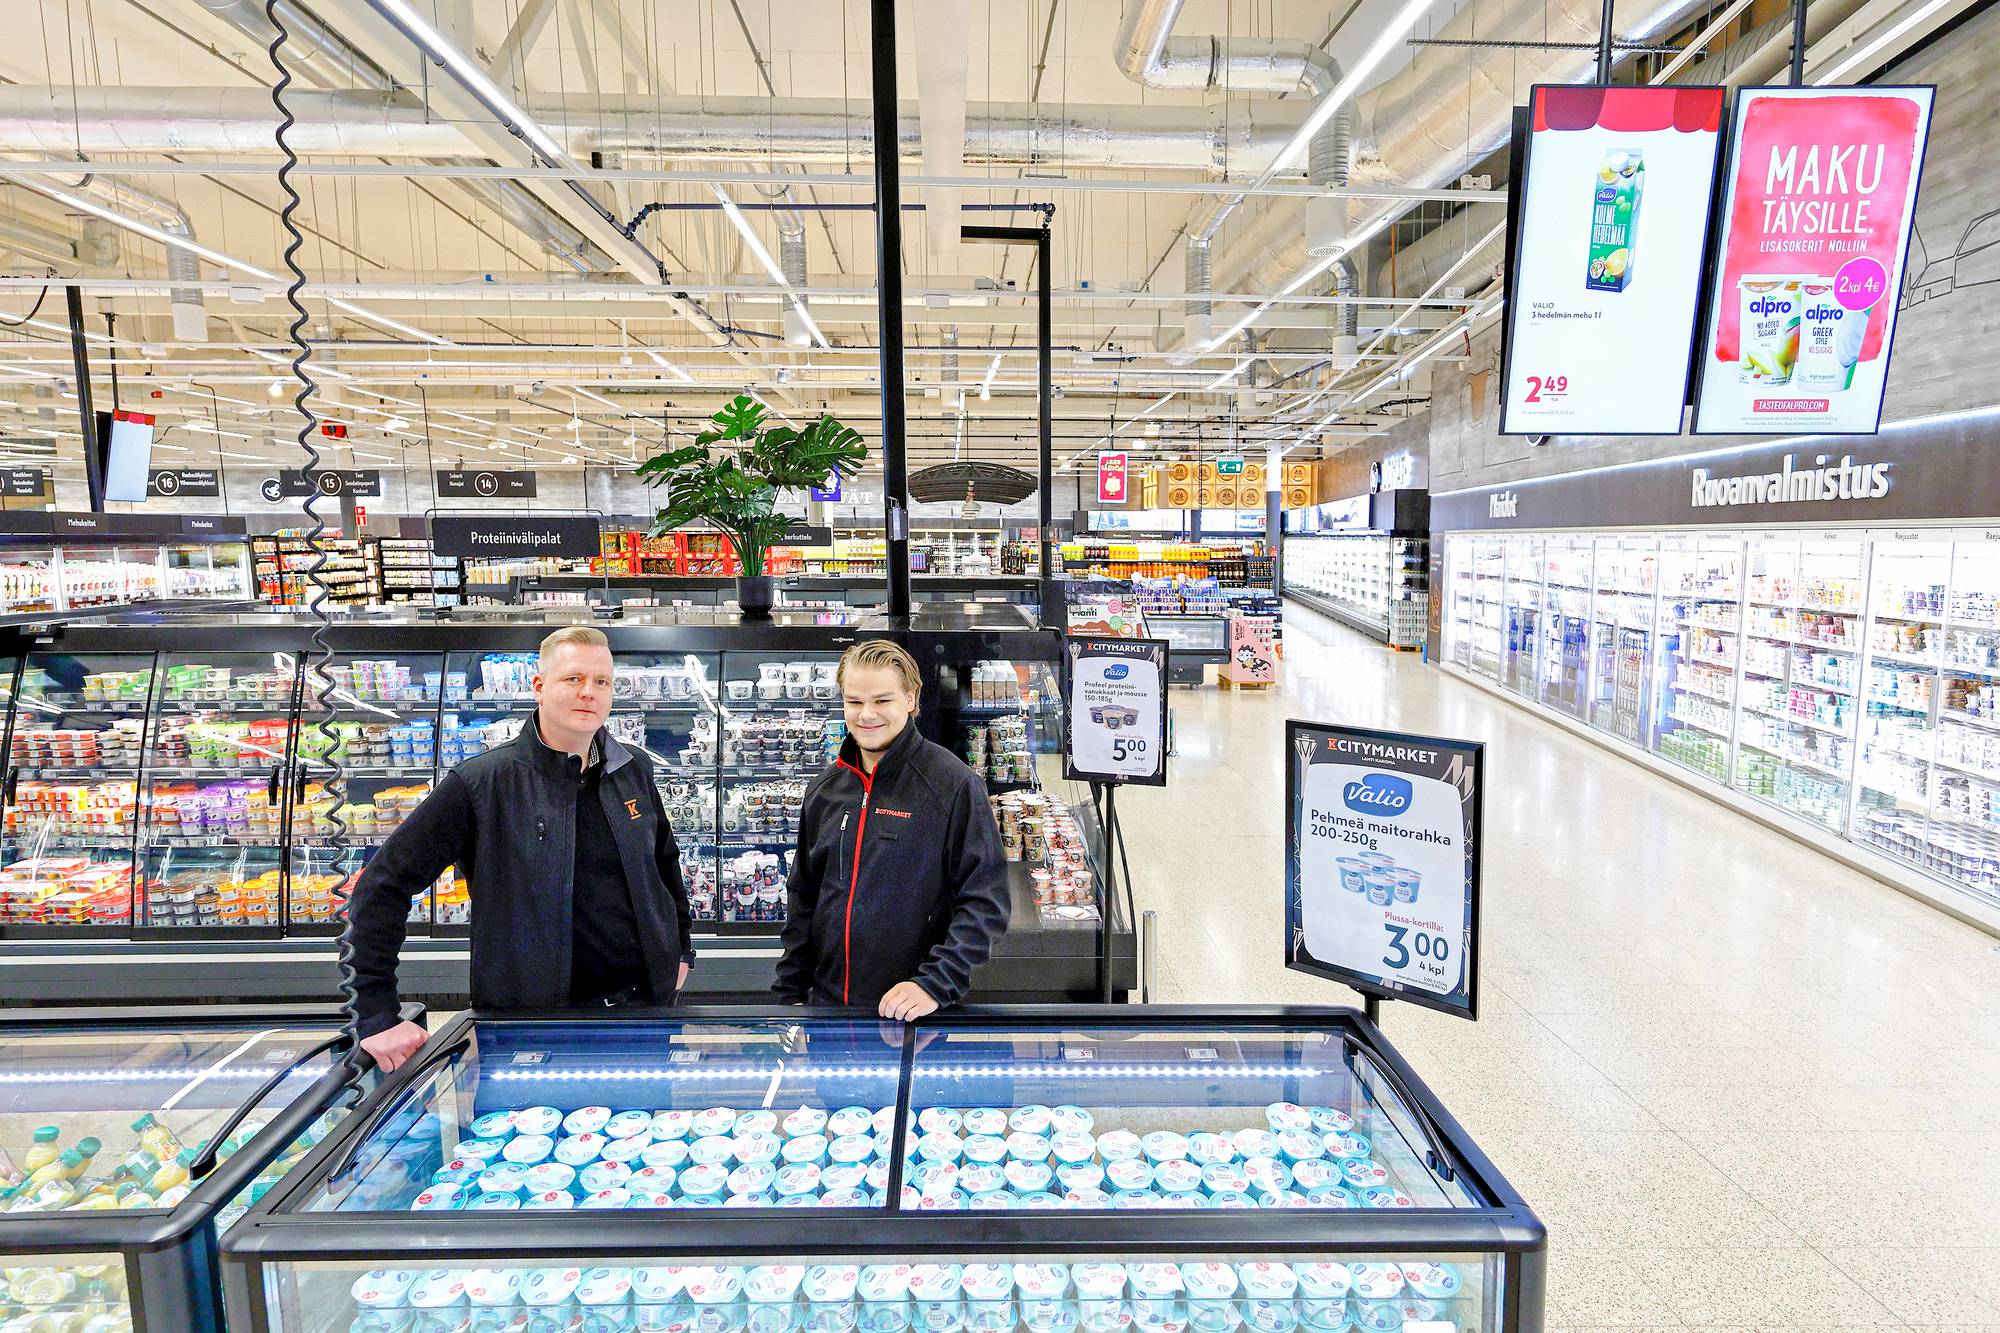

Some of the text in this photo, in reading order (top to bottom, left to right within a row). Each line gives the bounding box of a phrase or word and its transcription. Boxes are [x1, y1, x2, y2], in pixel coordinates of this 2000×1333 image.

[1765, 143, 1885, 195] MAKU
[1762, 196, 1874, 234] TÄYSILLE.
[1760, 239, 1824, 253] LISÄSOKERIT
[1750, 295, 1792, 318] alpro
[1806, 304, 1843, 324] alpro
[1531, 311, 1537, 319] 3
[1537, 311, 1572, 319] hedelmän
[1573, 311, 1593, 319] mehu
[1812, 327, 1834, 337] GREEK
[1758, 400, 1825, 410] TASTEOFALPRO.COM
[161, 477, 174, 489] 16
[324, 478, 336, 489] 15
[480, 479, 492, 489] 14
[1691, 453, 1890, 507] Ruoanvalmistus
[1489, 490, 1518, 519] Maidot
[67, 518, 97, 528] Mehukeitot
[191, 520, 214, 529] Mehukeitot
[471, 531, 562, 547] Proteiinivälipalat
[1105, 668, 1127, 677] Valio
[1084, 680, 1107, 689] Profeel
[1084, 688, 1116, 696] vanukkaat
[1084, 694, 1113, 704] 150-185g
[1347, 785, 1405, 808] Valio
[626, 801, 640, 818] K
[1311, 808, 1451, 846] Pehmeä maitorahka
[1310, 823, 1378, 851] 200-250g
[1384, 911, 1444, 932] Plussa-kortilla:
[1419, 961, 1445, 977] 4 kpl
